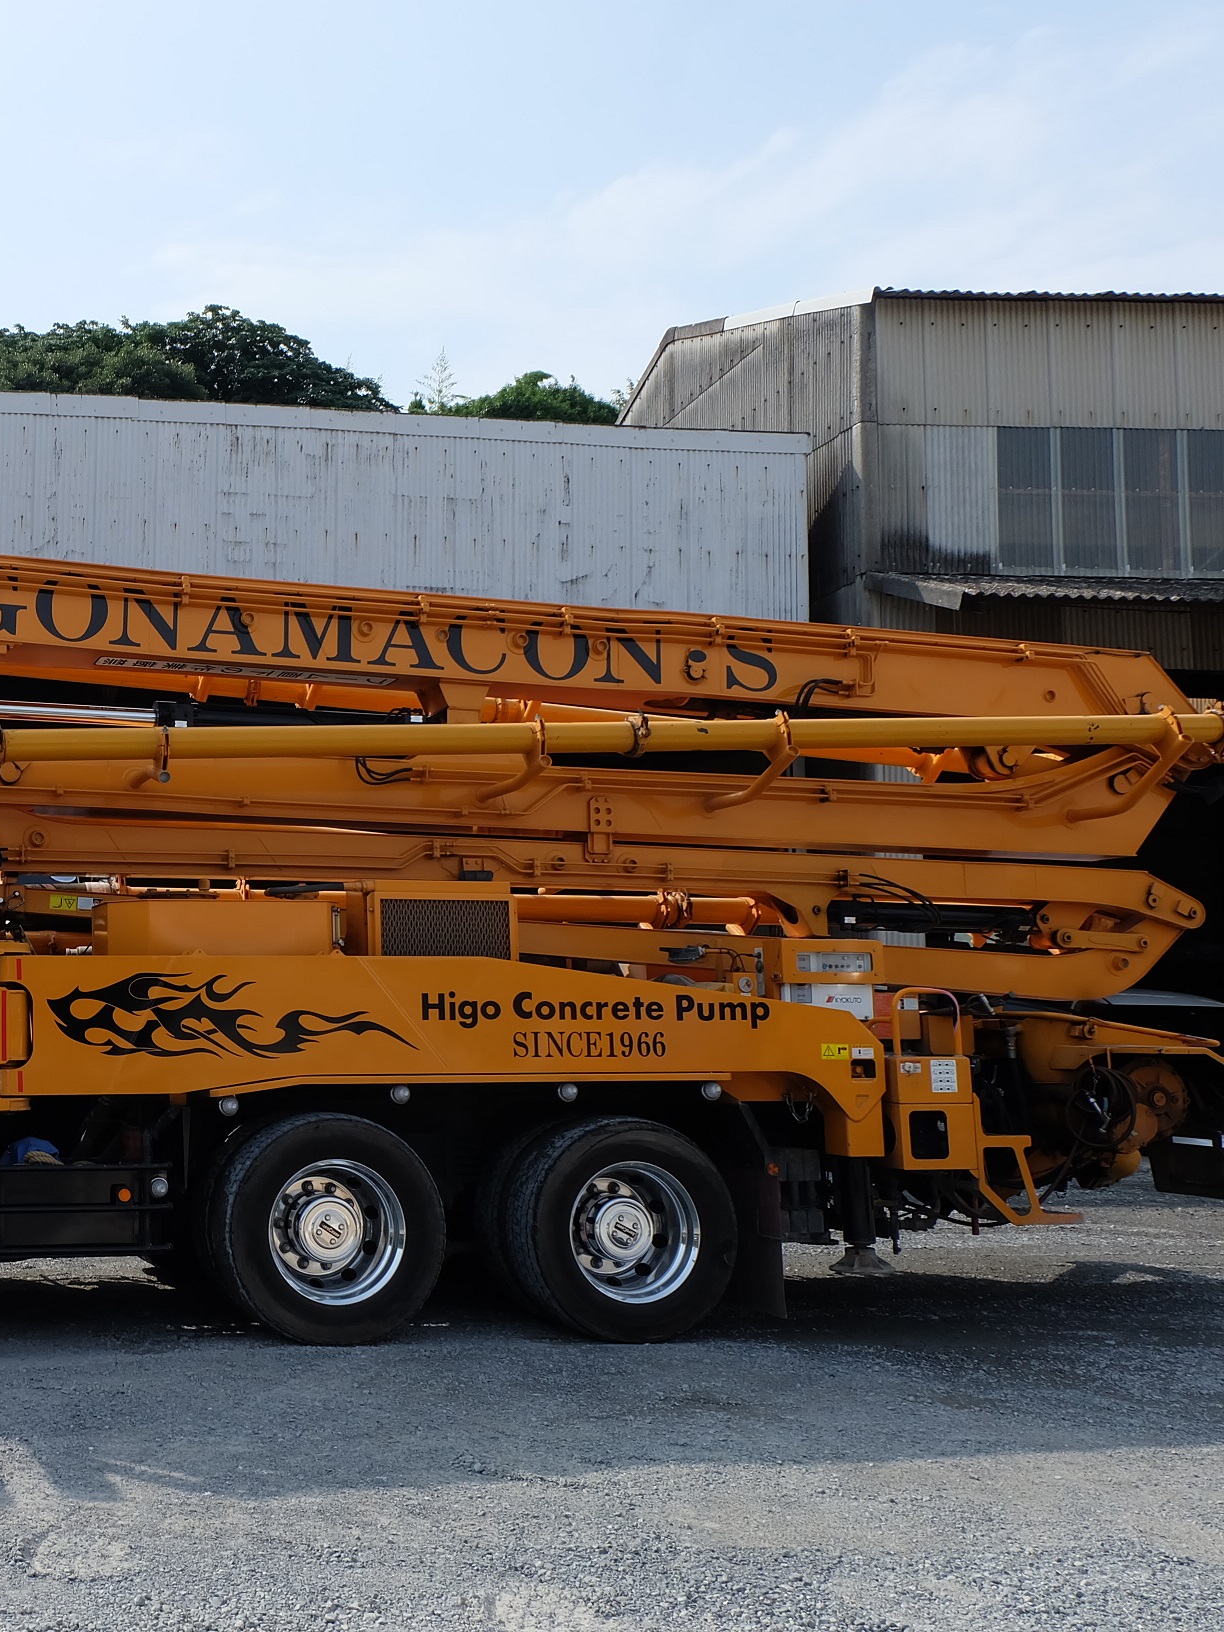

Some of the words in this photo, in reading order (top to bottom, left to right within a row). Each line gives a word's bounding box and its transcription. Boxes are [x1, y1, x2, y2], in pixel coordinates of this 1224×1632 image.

[421, 991, 502, 1029] Higo
[512, 991, 665, 1021] Concrete
[675, 994, 770, 1029] Pump
[513, 1031, 667, 1058] SINCE1966
